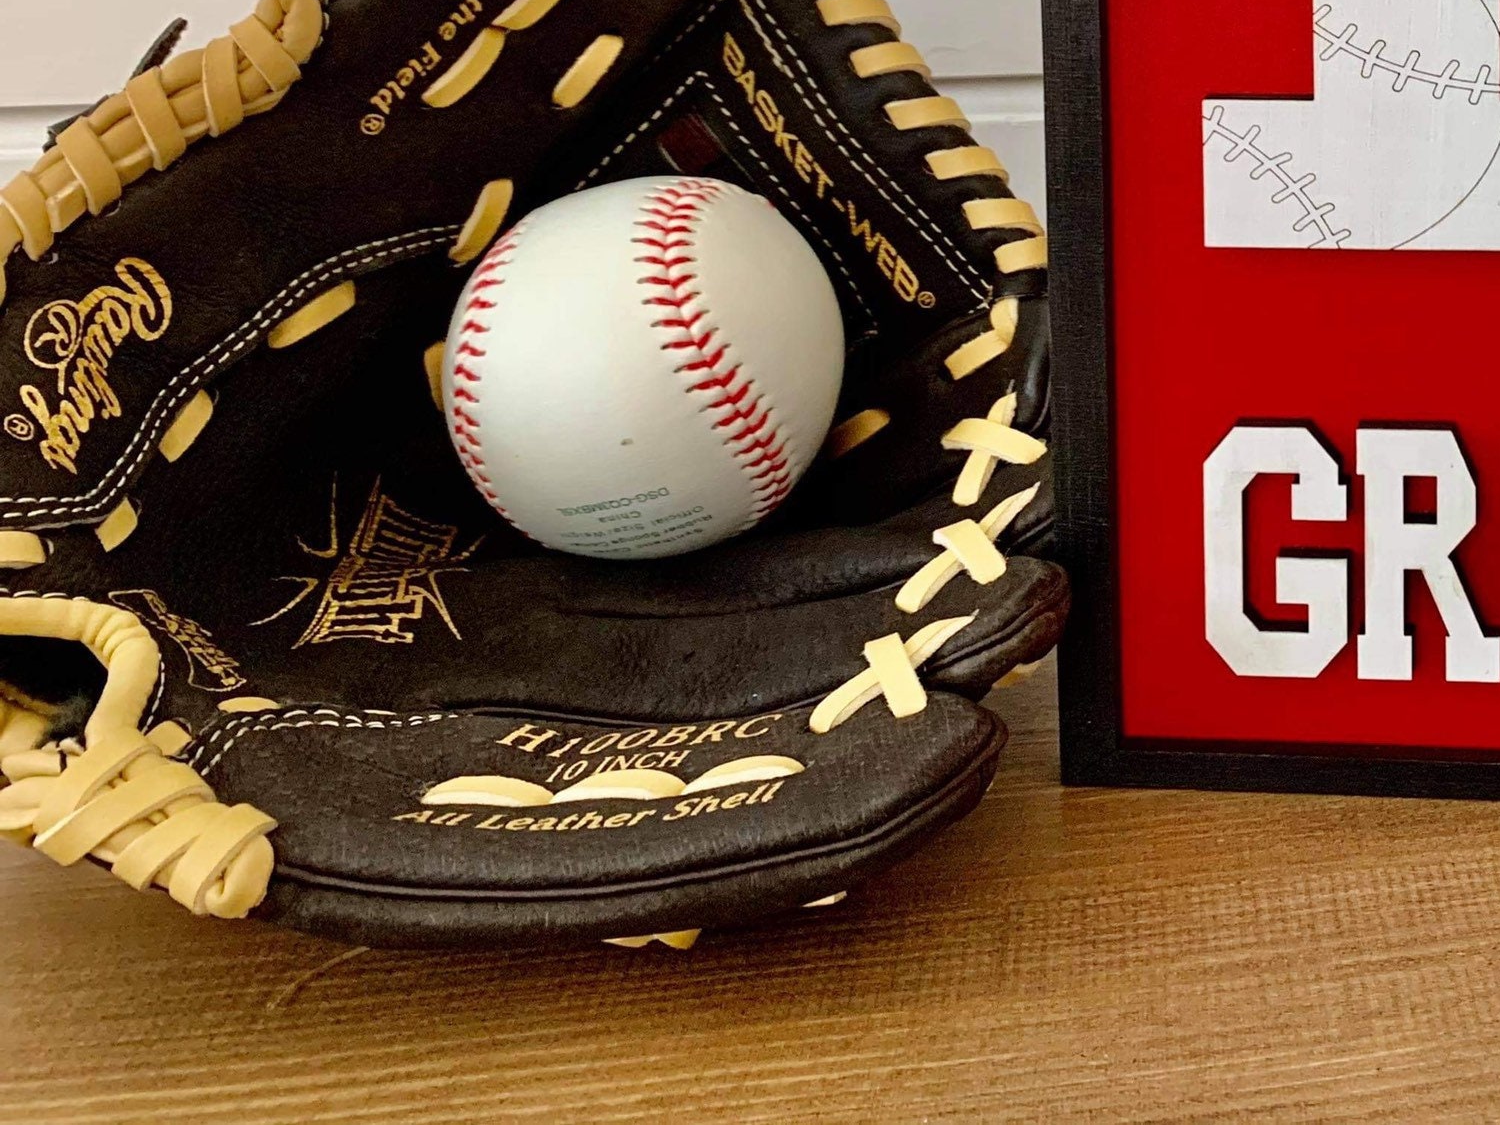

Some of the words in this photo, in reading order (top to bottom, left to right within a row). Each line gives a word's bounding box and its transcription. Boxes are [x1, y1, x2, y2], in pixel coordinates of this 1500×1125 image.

[598, 510, 642, 523] China
[545, 760, 589, 784] 10
[591, 749, 692, 775] INCH
[392, 809, 471, 828] All
[475, 805, 657, 832] Leather
[661, 780, 785, 822] Shell
